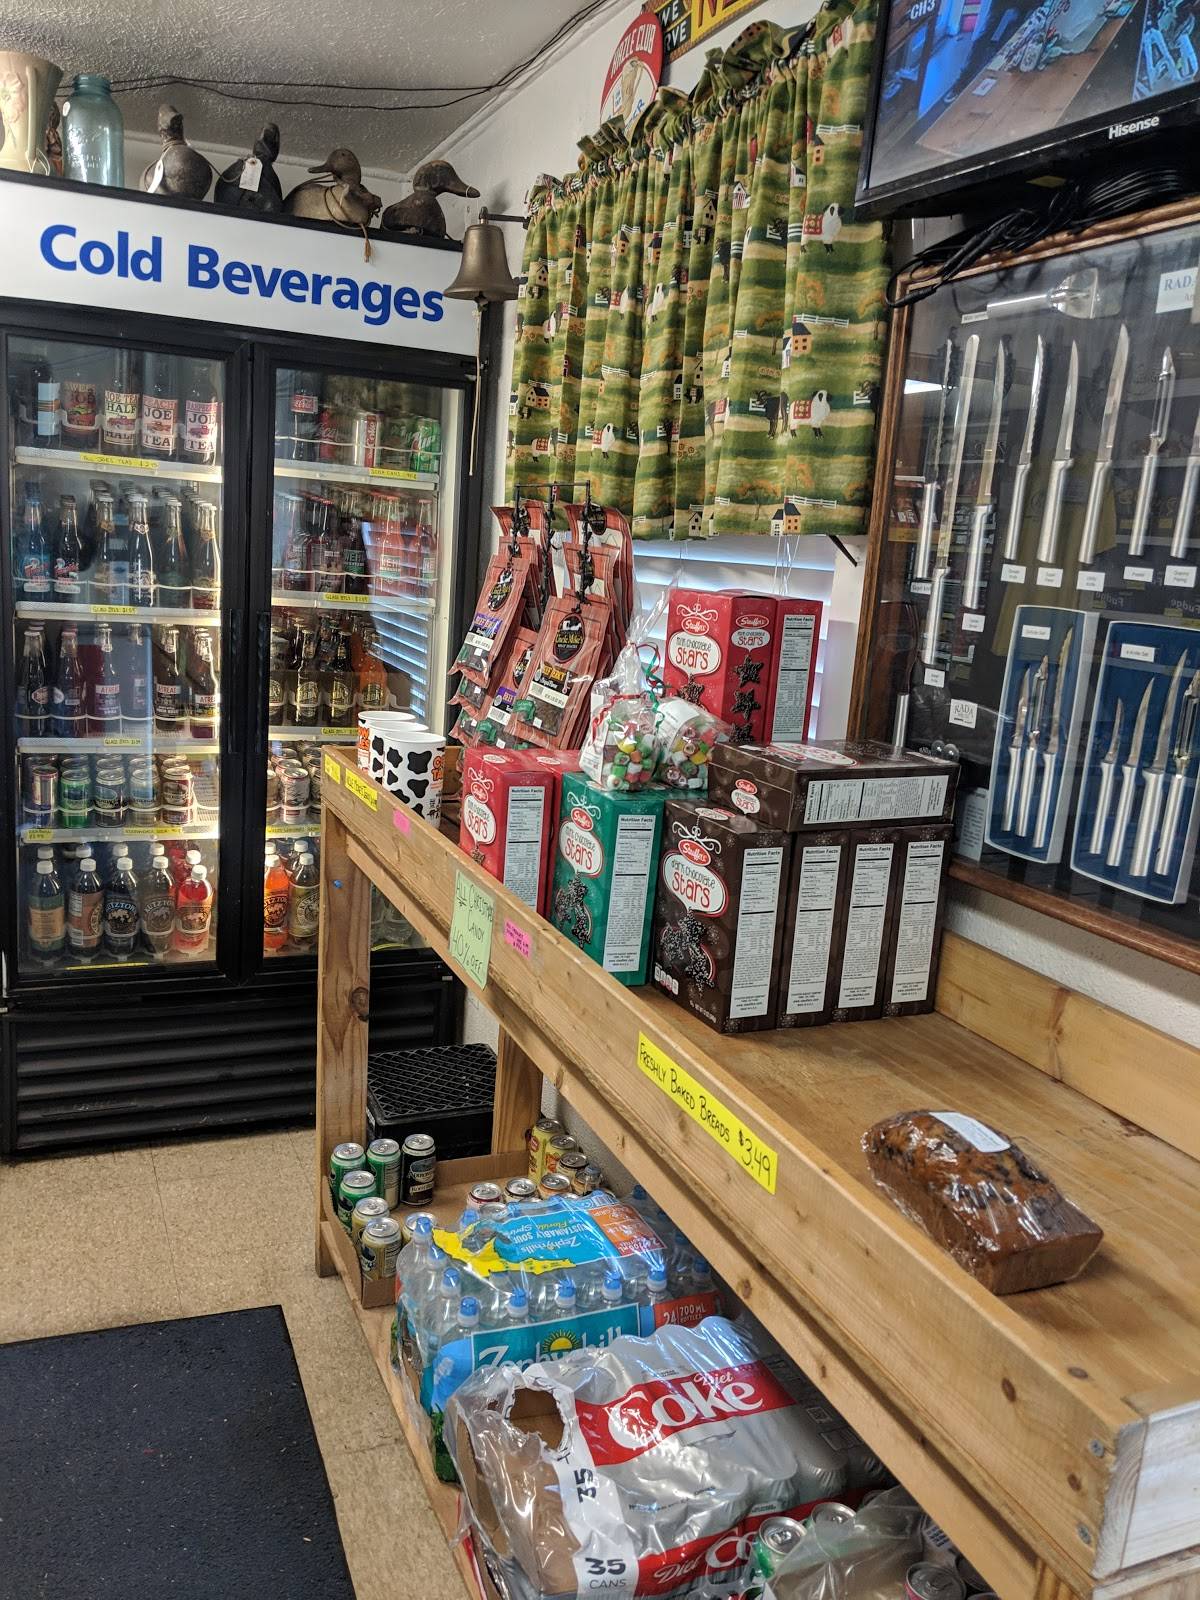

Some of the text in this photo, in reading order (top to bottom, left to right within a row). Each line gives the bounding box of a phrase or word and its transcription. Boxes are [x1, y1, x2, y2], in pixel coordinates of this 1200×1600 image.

[910, 0, 936, 19] CH3
[636, 22, 657, 54] CLUB
[1108, 115, 1160, 140] Hisense
[40, 223, 445, 326] Cold Beverages
[1163, 275, 1194, 291] RAD
[144, 407, 172, 421] JOE
[144, 435, 171, 446] TEA
[737, 635, 764, 646] stars
[676, 647, 709, 671] stars
[954, 702, 975, 718] RADA
[468, 810, 488, 840] stars
[565, 837, 593, 870] stars
[685, 866, 716, 890] chocolate
[672, 871, 711, 909] stars
[640, 1042, 772, 1187] FRESHLY BAKED BREADS $3.49
[520, 1235, 583, 1255] Zephyrhills
[663, 1309, 677, 1326] 24
[679, 1304, 695, 1317] 700
[693, 1371, 735, 1387] Diet
[607, 1380, 764, 1450] Coke
[573, 1468, 597, 1503] 35
[653, 1525, 759, 1584] Diet Co
[584, 1557, 626, 1576] 35
[589, 1578, 627, 1590] CANS
